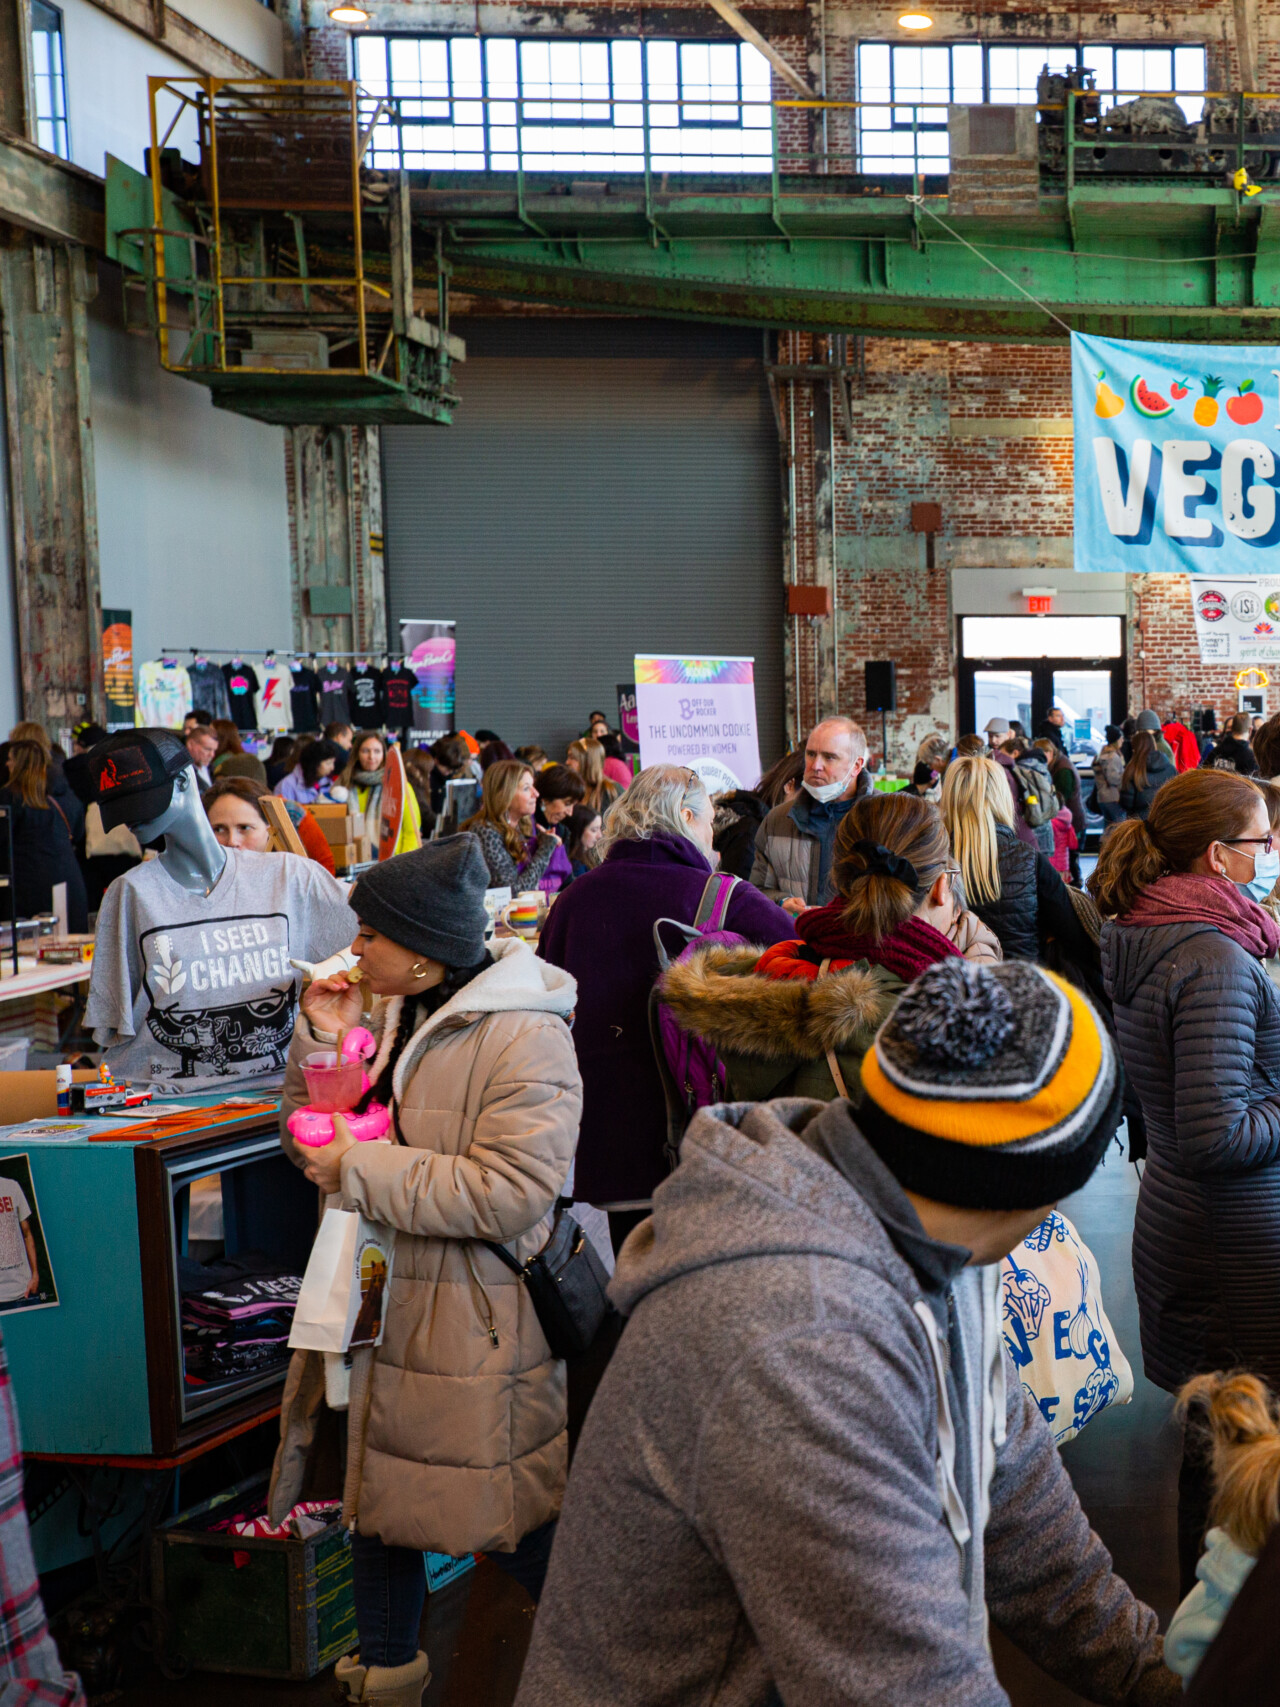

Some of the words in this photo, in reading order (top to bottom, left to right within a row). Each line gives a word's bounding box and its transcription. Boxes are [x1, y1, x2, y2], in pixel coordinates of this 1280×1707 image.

[692, 699, 703, 707] OFF
[703, 699, 714, 707] OUR
[695, 707, 717, 716] ROCKER
[649, 725, 667, 739] THE
[670, 724, 720, 739] UNCOMMON
[722, 723, 752, 738] COOKIE
[667, 744, 700, 757] POWERED
[701, 744, 711, 755] BY
[712, 743, 737, 755] WOMEN
[199, 930, 211, 955] I
[212, 922, 269, 954] SEED
[190, 945, 294, 992] CHANGE
